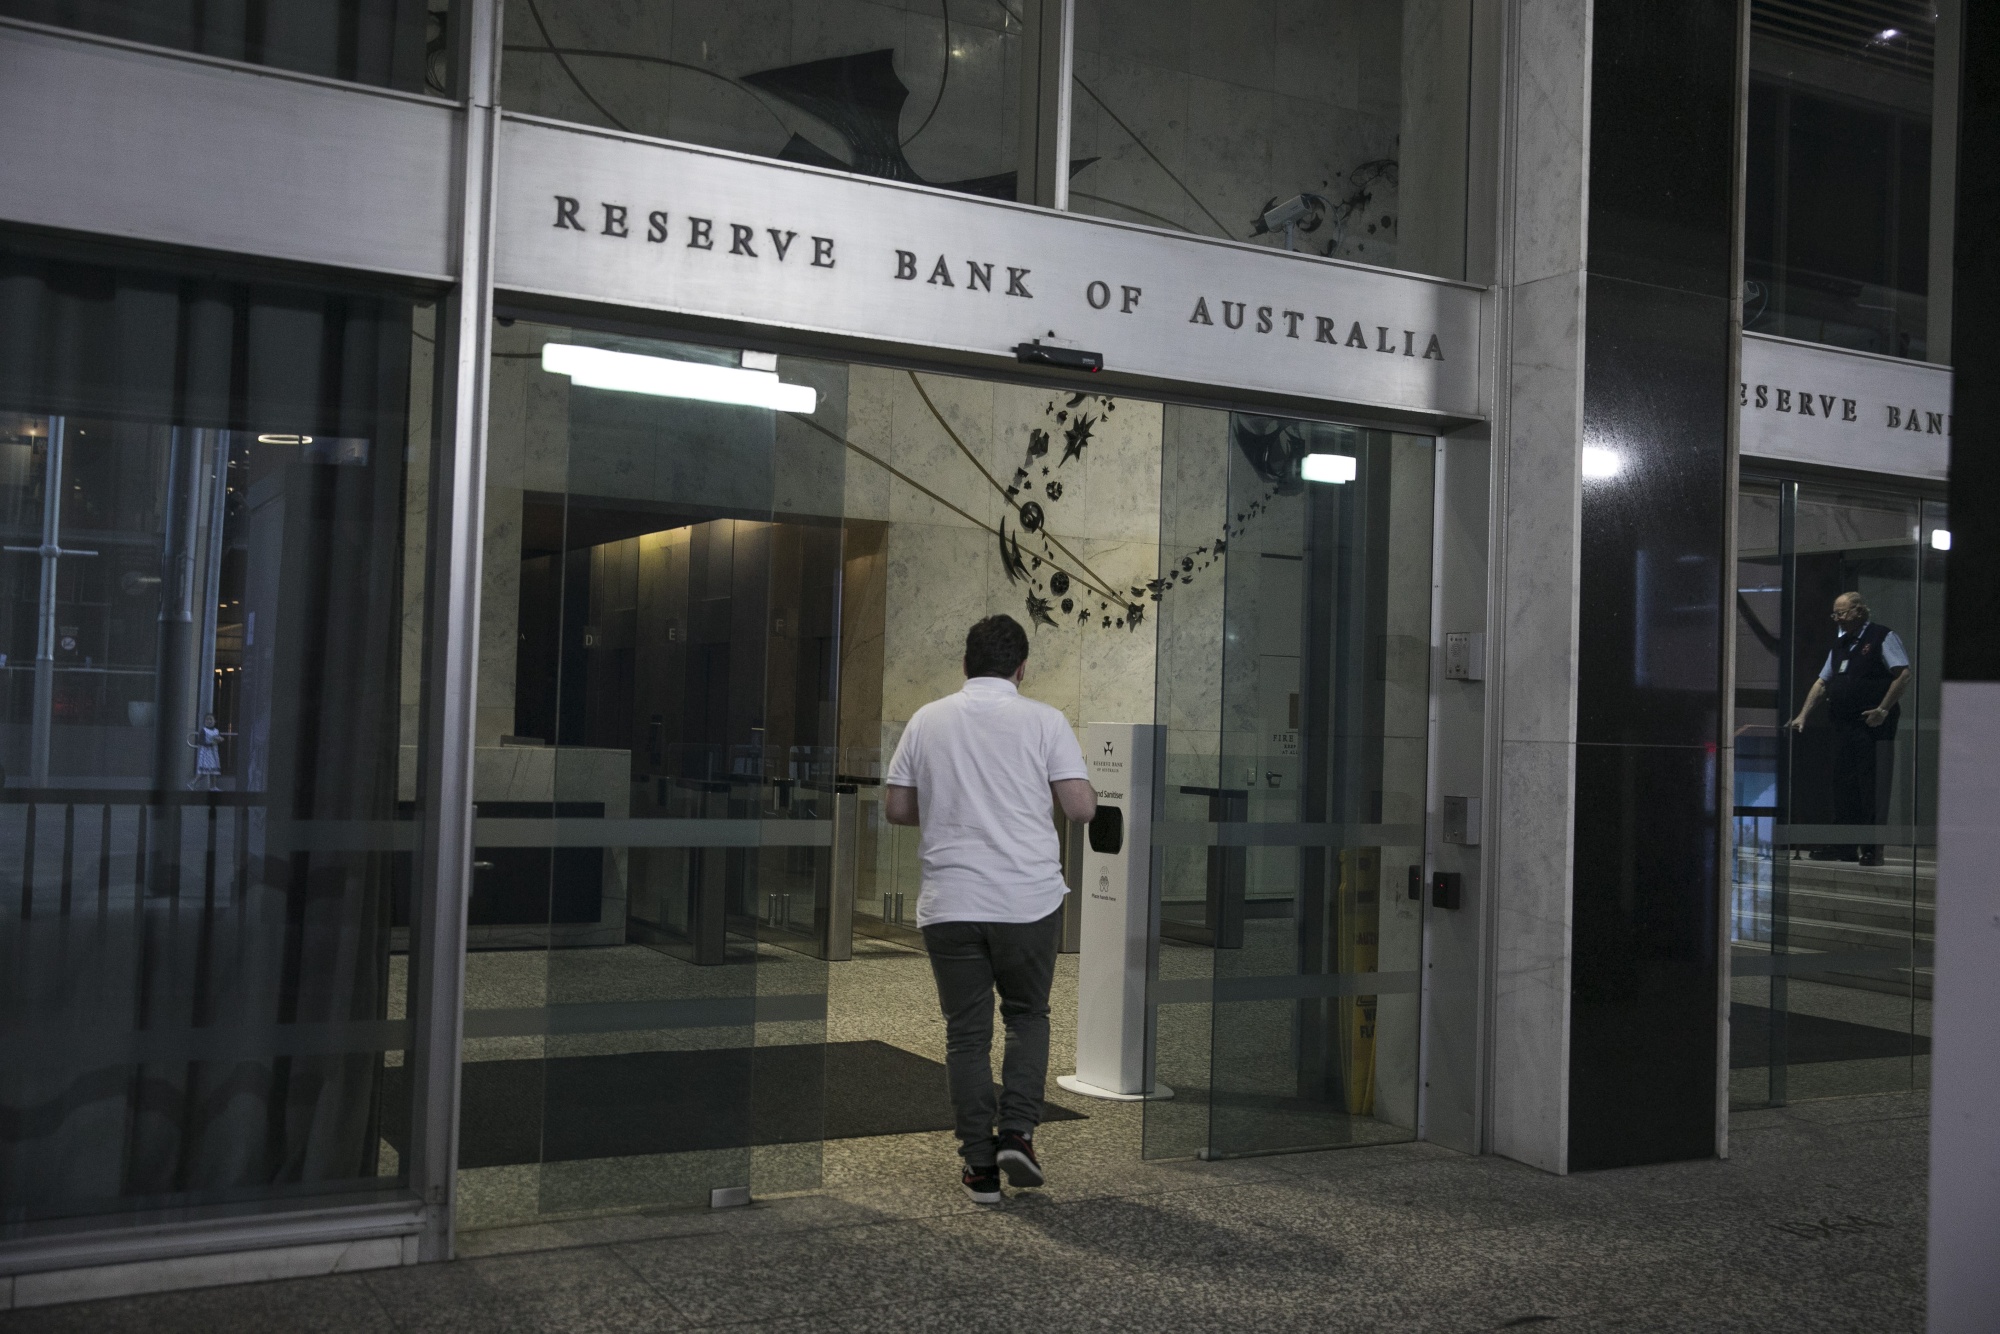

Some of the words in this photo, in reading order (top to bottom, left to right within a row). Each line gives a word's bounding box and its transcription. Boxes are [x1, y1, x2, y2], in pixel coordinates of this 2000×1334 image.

[553, 195, 836, 269] RESERVE
[894, 249, 1034, 299] BANK
[1086, 280, 1142, 314] OF
[1189, 296, 1445, 361] AUSTRALIA
[1886, 405, 1952, 437] BAN
[1272, 734, 1294, 742] FIRE
